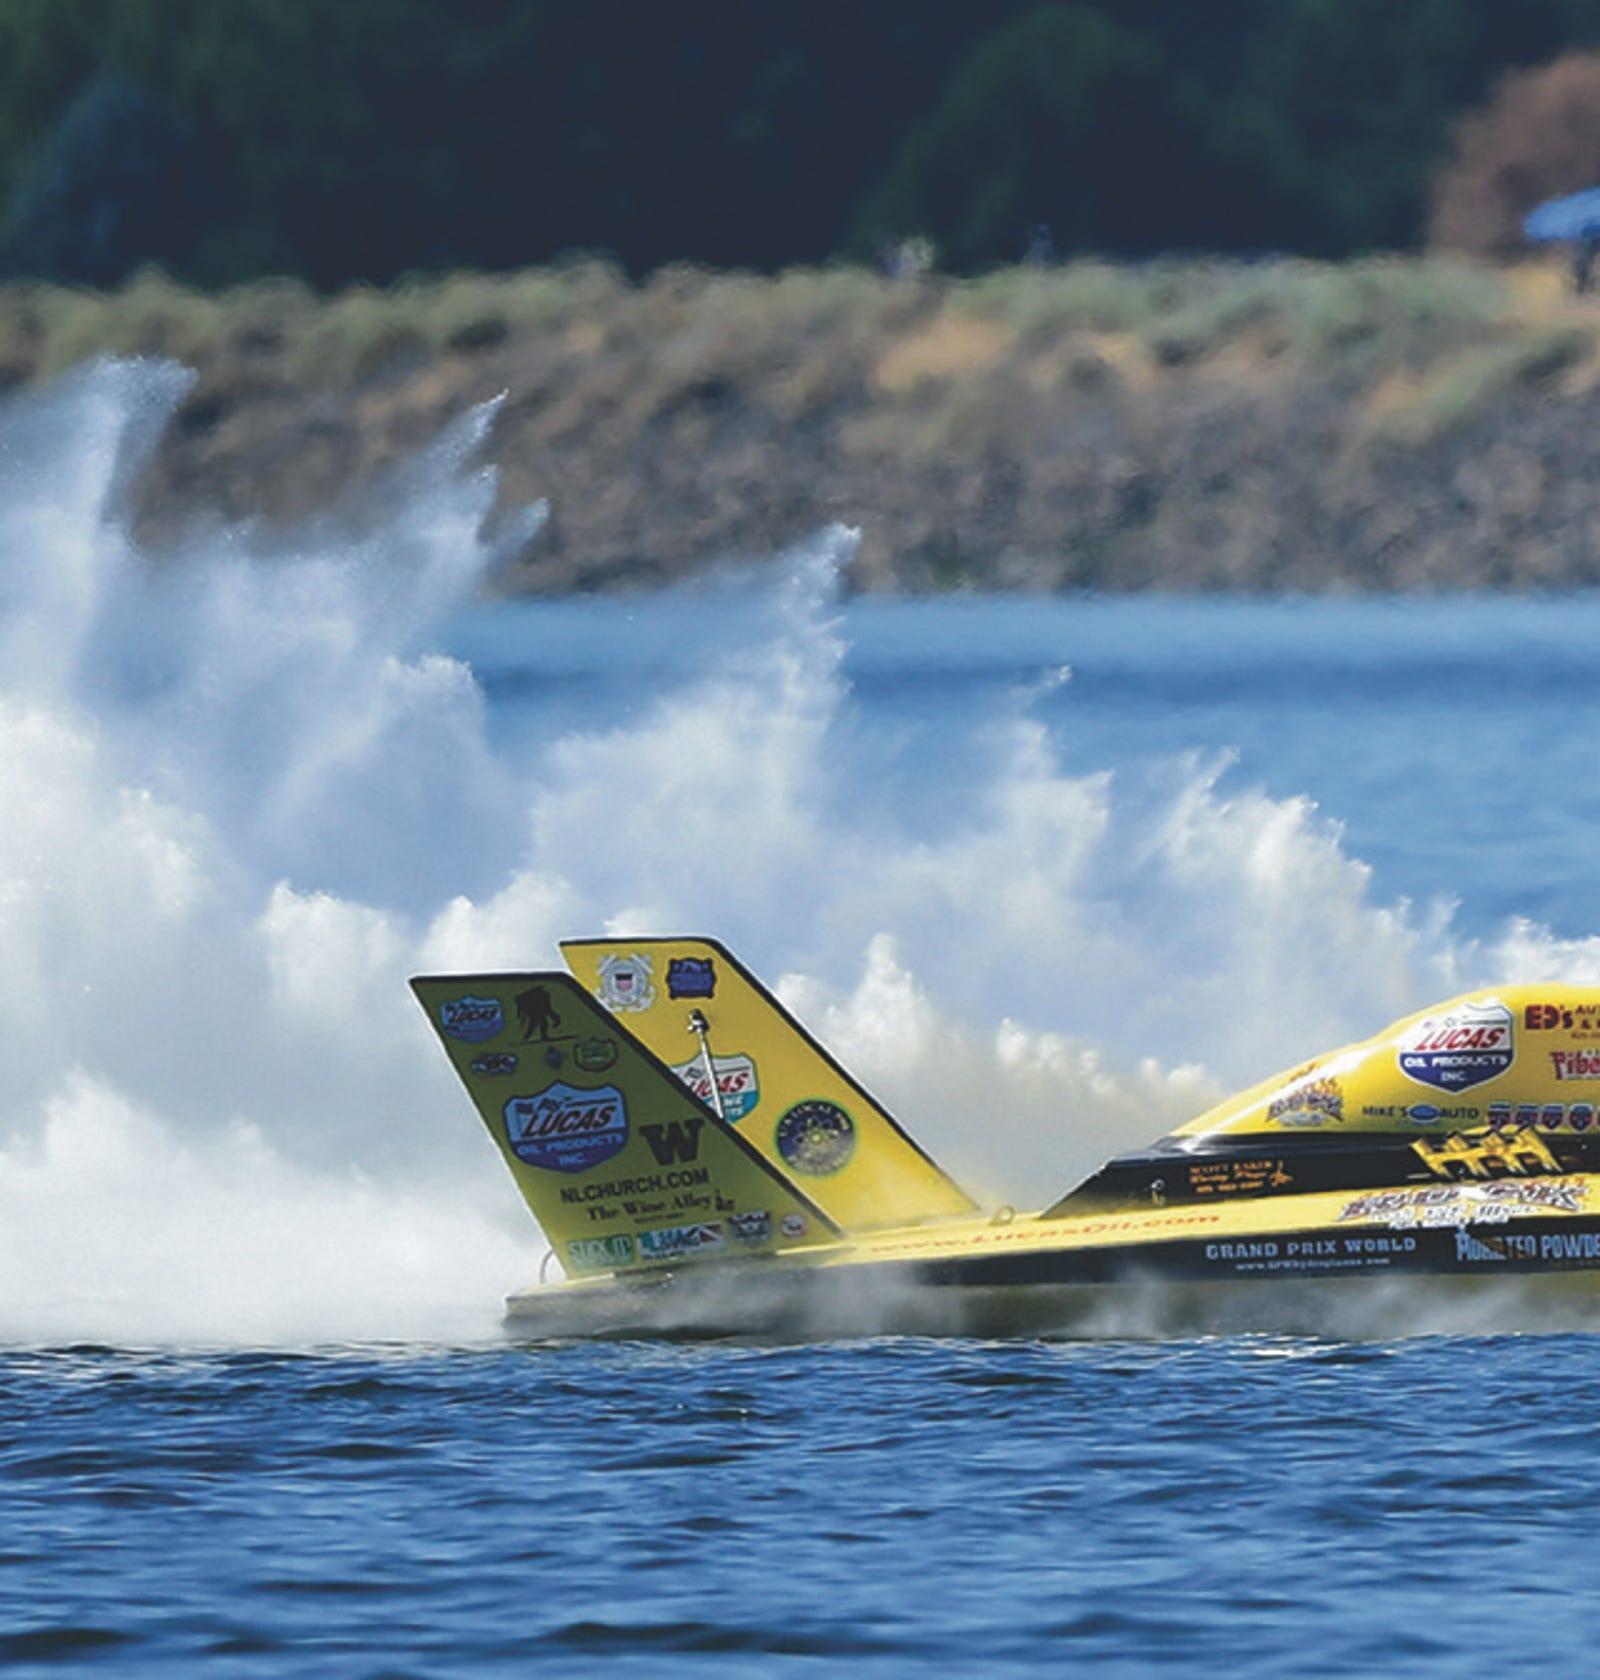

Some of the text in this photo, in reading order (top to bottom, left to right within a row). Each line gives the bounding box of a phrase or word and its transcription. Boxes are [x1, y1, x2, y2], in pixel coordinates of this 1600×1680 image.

[1580, 1019, 1592, 1029] &
[1414, 1027, 1506, 1051] LUCAS
[1404, 1055, 1508, 1068] OIL PRODUCTS
[521, 1105, 617, 1138] LUCAS
[1362, 1105, 1408, 1117] MIKE'S
[1440, 1107, 1480, 1119] AUTO
[517, 1134, 624, 1155] OIL PRODUCTS
[639, 1118, 705, 1166] W
[560, 1168, 709, 1204] NLCHURCH.COM
[588, 1206, 619, 1221] The
[623, 1200, 665, 1216] Wine
[1206, 1237, 1416, 1260] GRAND PRIX WORLD
